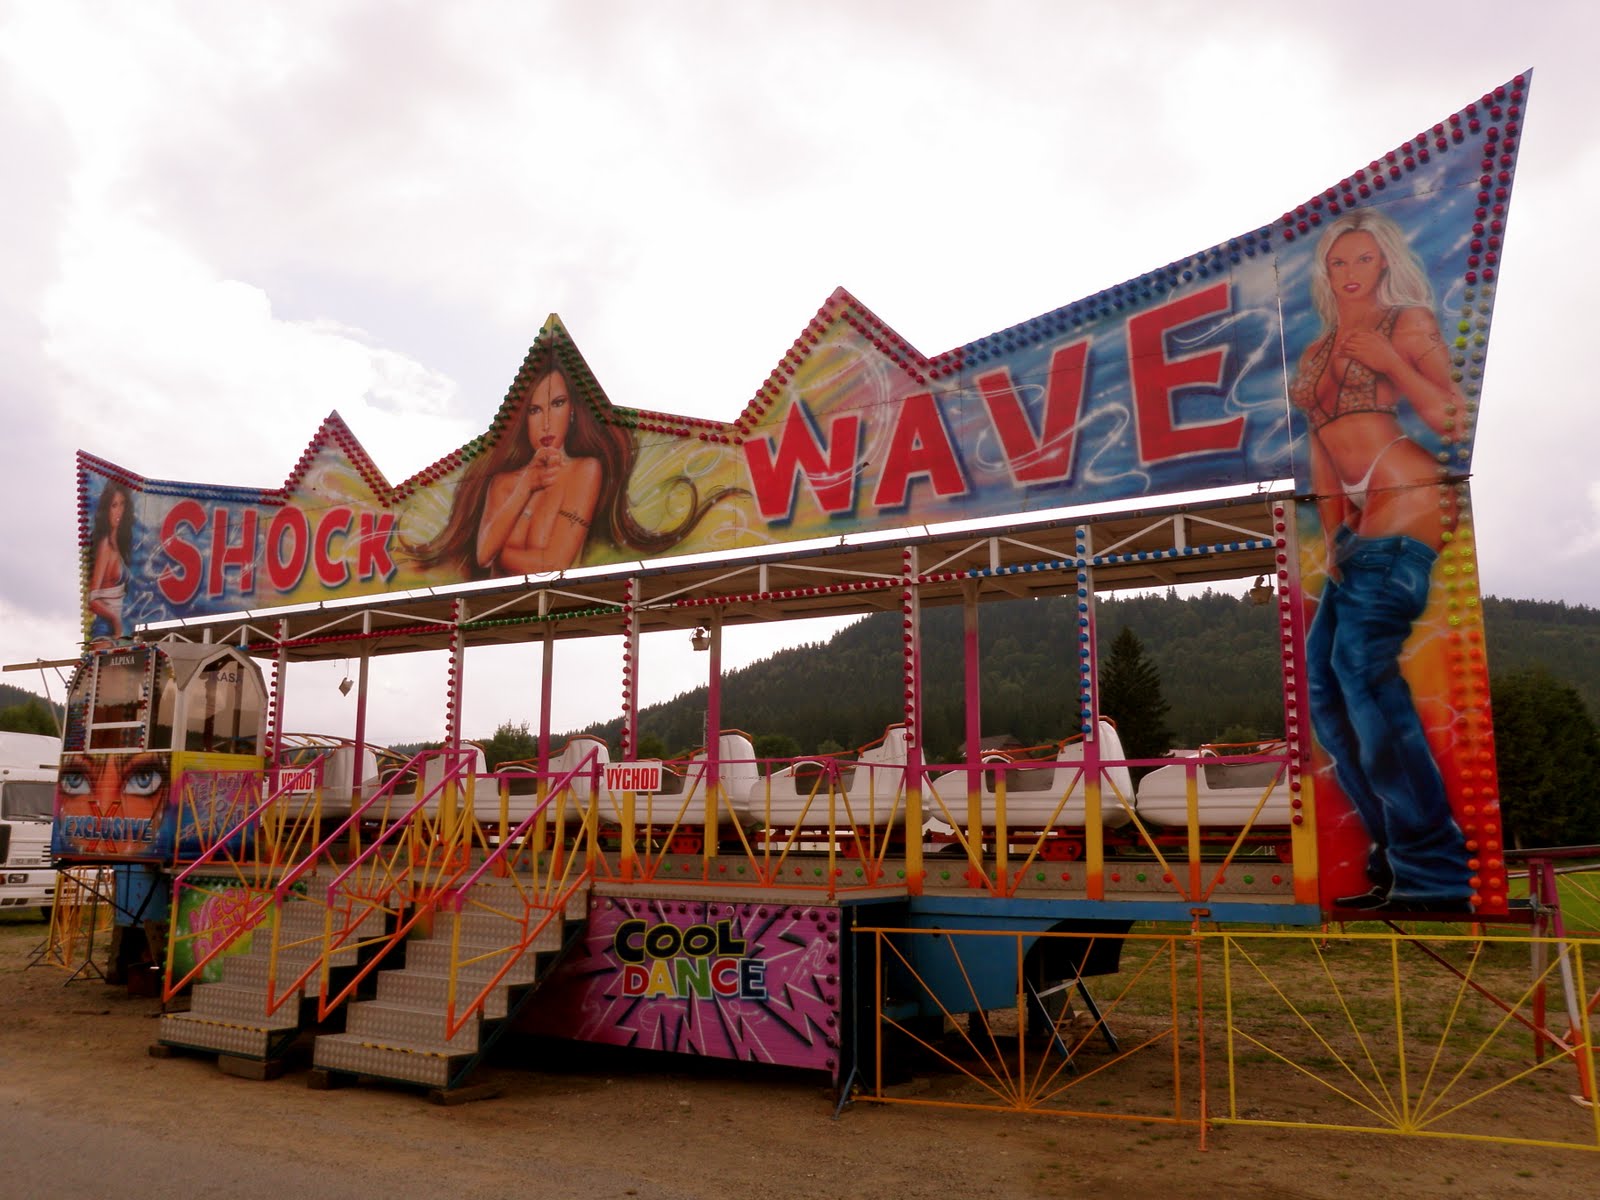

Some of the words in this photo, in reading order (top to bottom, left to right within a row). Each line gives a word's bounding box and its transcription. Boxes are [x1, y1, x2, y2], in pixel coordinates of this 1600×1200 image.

[156, 500, 397, 604] SHOCK
[742, 282, 1246, 520] WAVE
[110, 656, 135, 666] ALPINA
[606, 764, 659, 790] VÝCHOD
[64, 815, 152, 842] EXCLUSIVE
[614, 918, 746, 964] COOL
[622, 957, 767, 1000] DANCE
